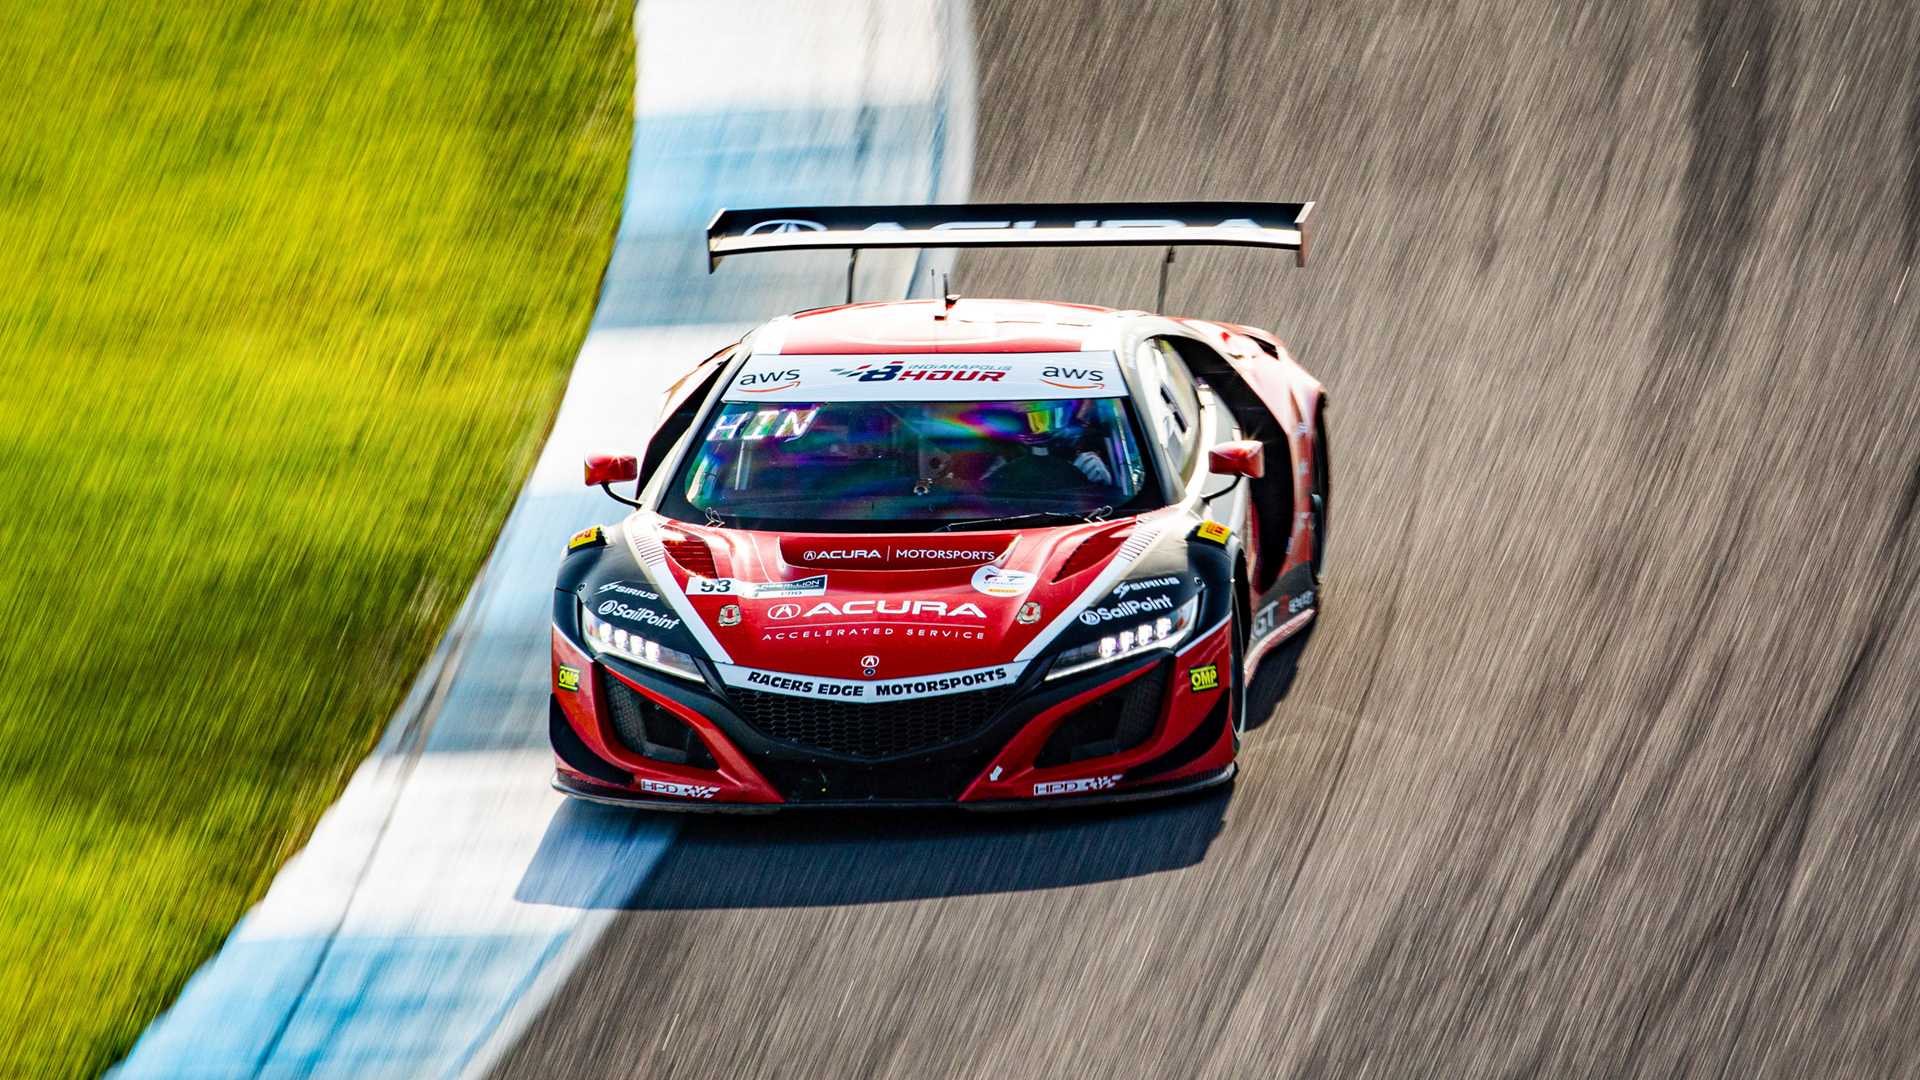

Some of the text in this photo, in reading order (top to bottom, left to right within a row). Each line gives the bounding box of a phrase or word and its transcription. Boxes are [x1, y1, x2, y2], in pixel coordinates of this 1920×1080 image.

[740, 369, 801, 386] aws
[897, 370, 1006, 382] HOUR
[1042, 366, 1104, 381] aws
[706, 409, 818, 442] HIN
[817, 549, 995, 560] ACURA MOTORSPORTS
[615, 585, 659, 600] SIRIUS
[802, 601, 987, 618] ACURA
[1097, 594, 1173, 621] SailPoint
[612, 603, 681, 630] SailPoint
[762, 628, 985, 641] ACCELERATED SERVICE
[559, 670, 579, 687] OMP
[747, 668, 1007, 697] RACERS EDGE MOTORSPORTS
[1191, 669, 1217, 687] OMP
[642, 780, 678, 794] HPD
[1035, 782, 1079, 794] HPD
